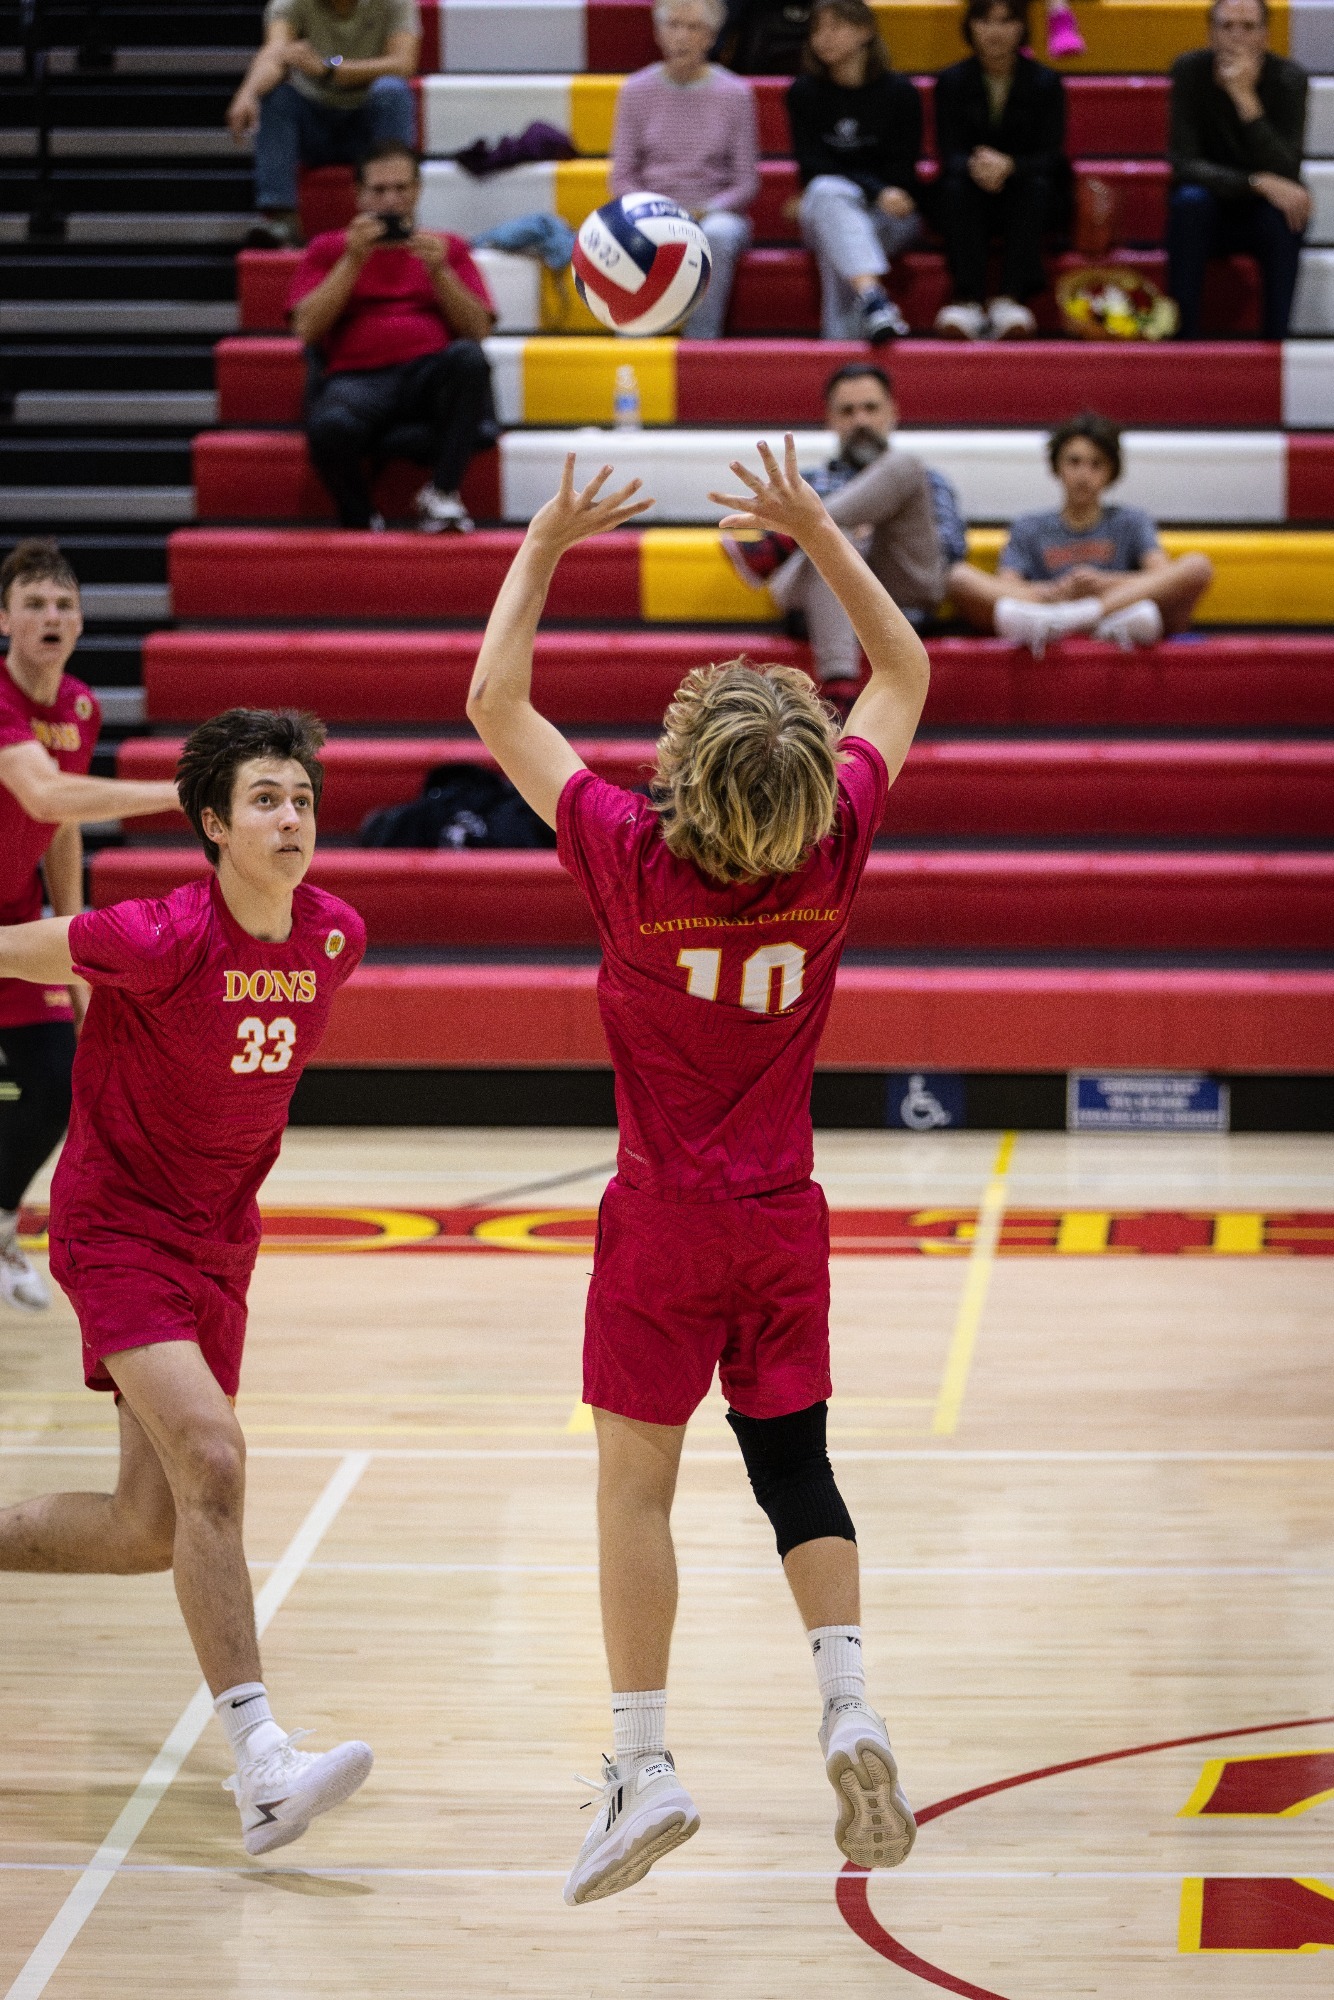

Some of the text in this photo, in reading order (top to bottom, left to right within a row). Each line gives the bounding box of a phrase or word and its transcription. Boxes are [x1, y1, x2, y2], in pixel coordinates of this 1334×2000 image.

[639, 909, 840, 935] CATHEDRAL CATHOLIC
[222, 969, 317, 1003] DONS
[676, 941, 808, 1015] 10
[229, 1016, 297, 1075] 33
